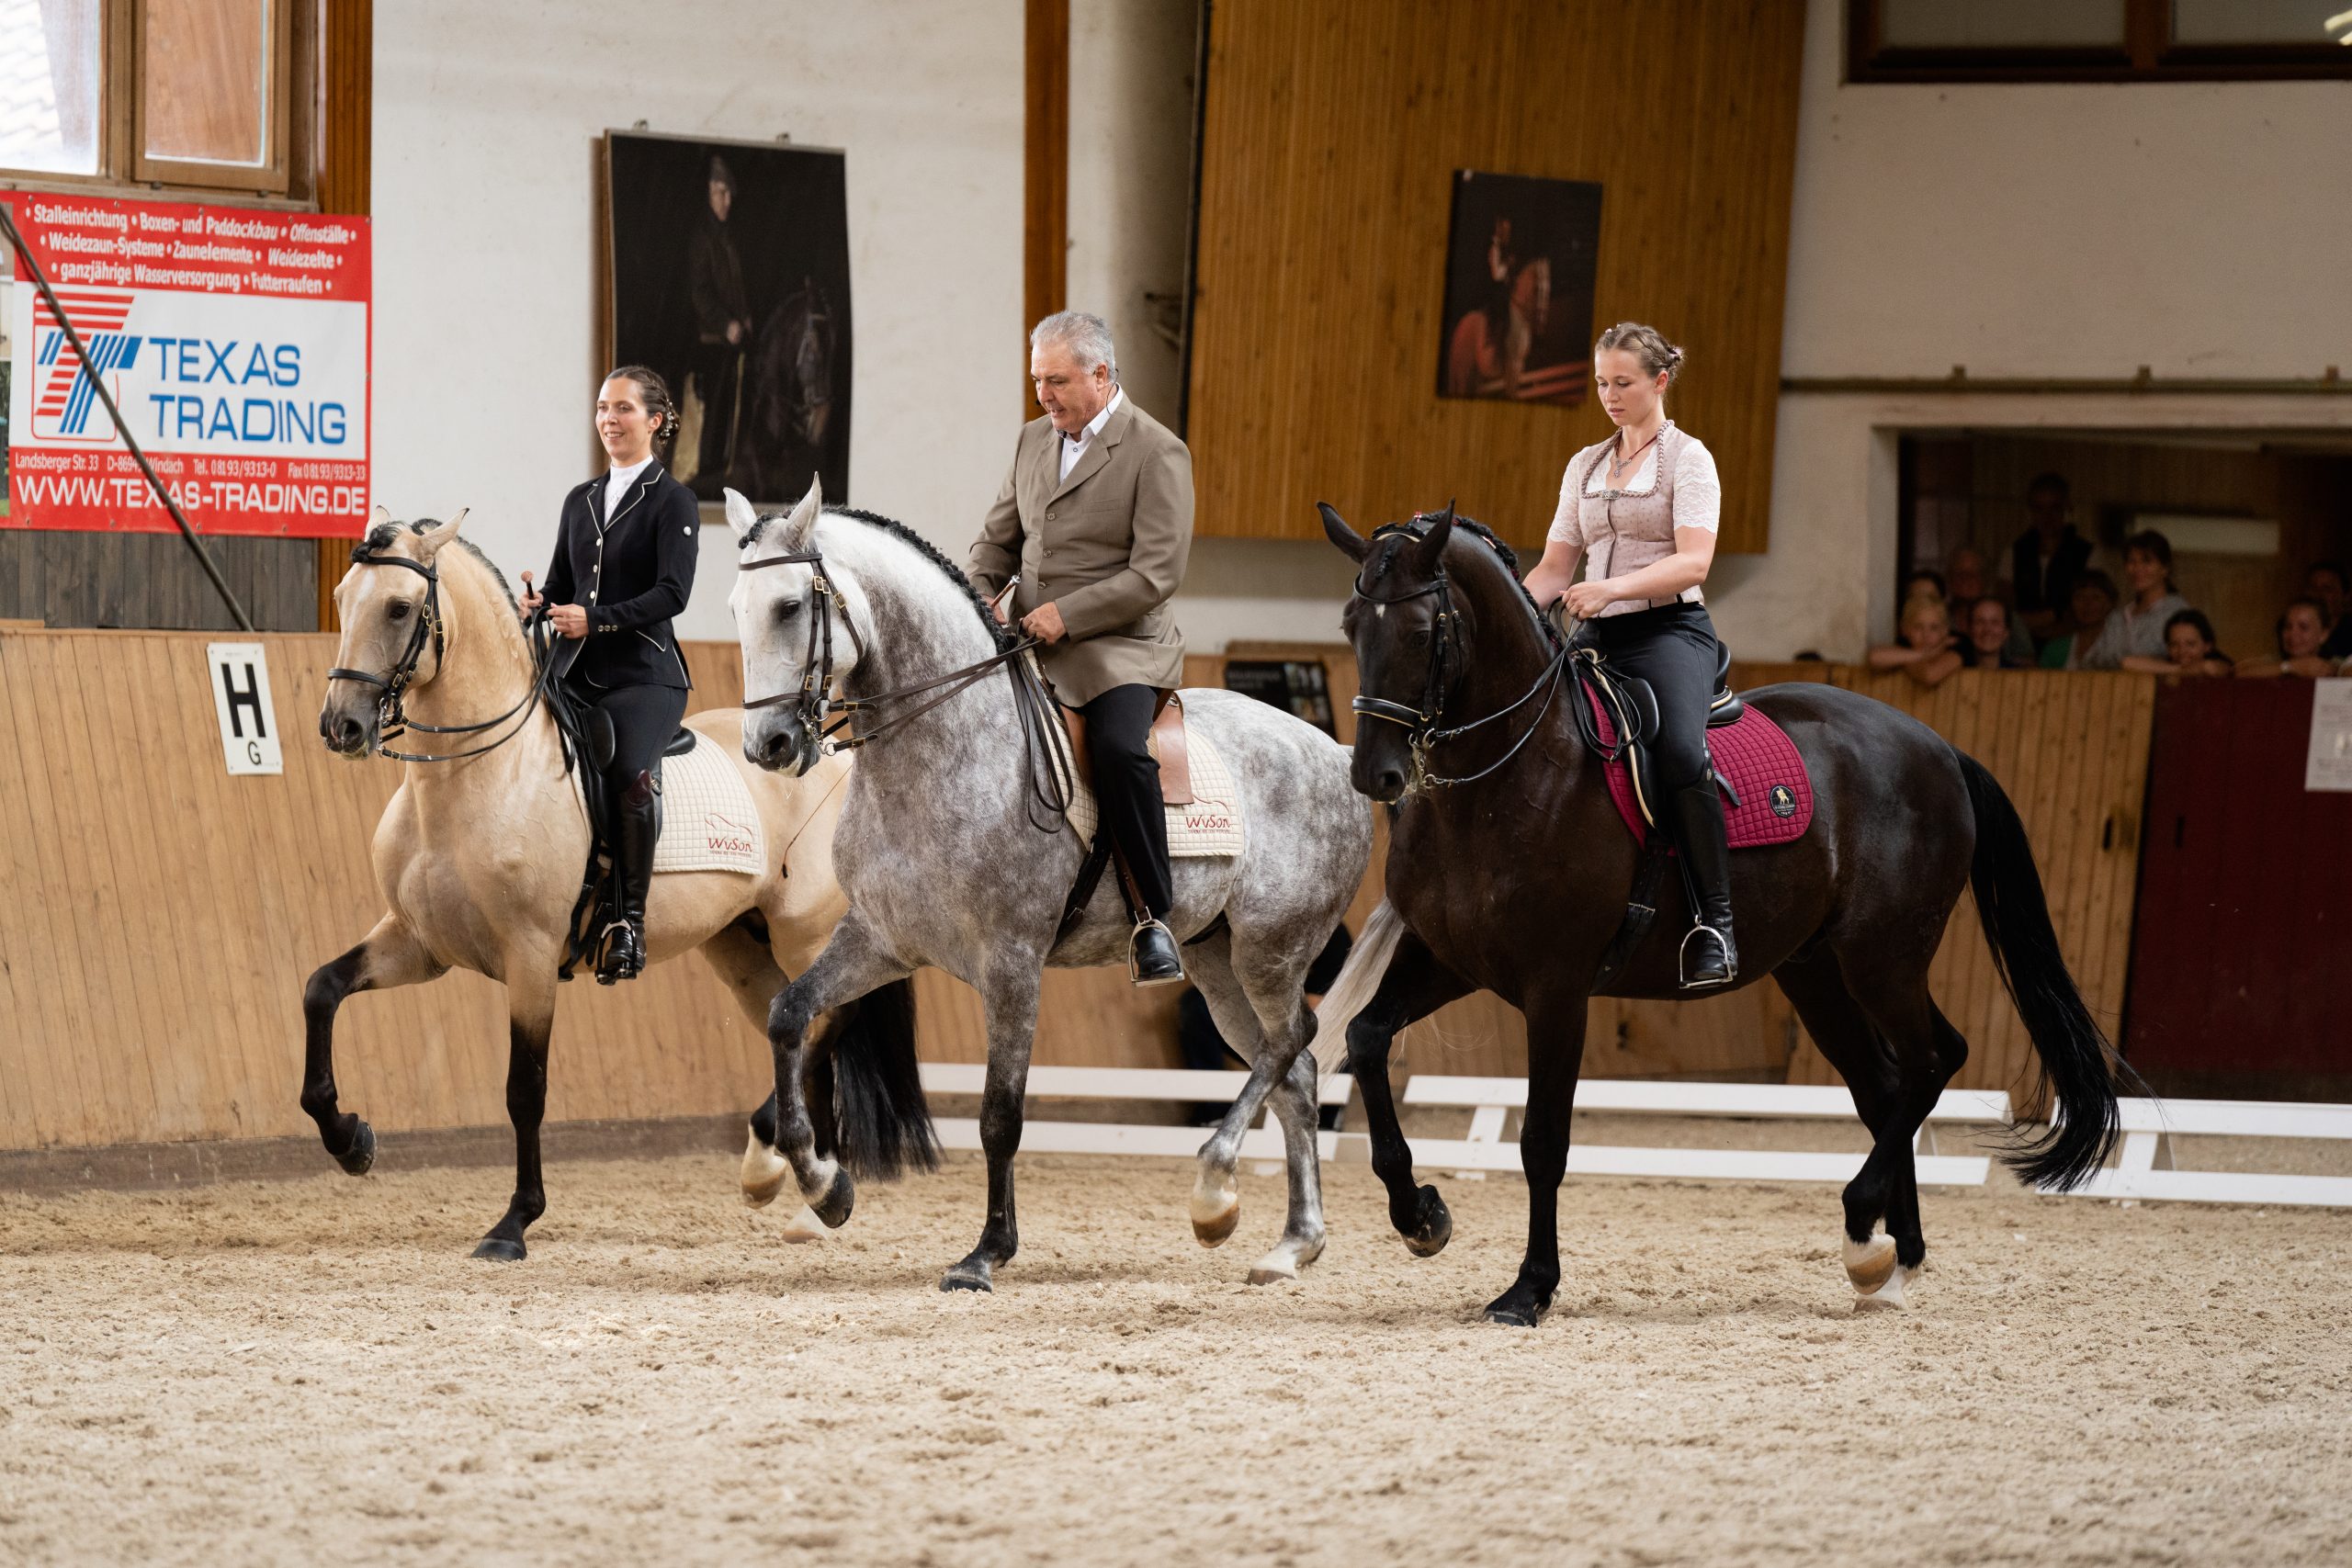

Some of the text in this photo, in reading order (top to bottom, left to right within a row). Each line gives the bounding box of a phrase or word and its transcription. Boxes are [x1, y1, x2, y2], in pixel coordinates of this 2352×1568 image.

[34, 204, 349, 244] Stalleinrichtung Boxen- und Paddockbau Offenställe
[49, 231, 334, 269] Weidezaun-Systeme Zaunelemente Weidezelte
[61, 260, 322, 294] ganzjährige Wasserversorgung Futterraufen
[149, 336, 300, 388] TEXAS
[149, 394, 346, 446] TRADING
[15, 453, 71, 473] Landsberger
[73, 454, 86, 469] Str.
[88, 455, 99, 471] 33
[107, 456, 143, 472] D-8694
[193, 458, 208, 477] Tel.
[288, 462, 302, 479] Fax
[16, 475, 366, 516] WWW.TEXAS-TRADING.DE
[220, 662, 266, 738] H
[247, 740, 262, 765] G
